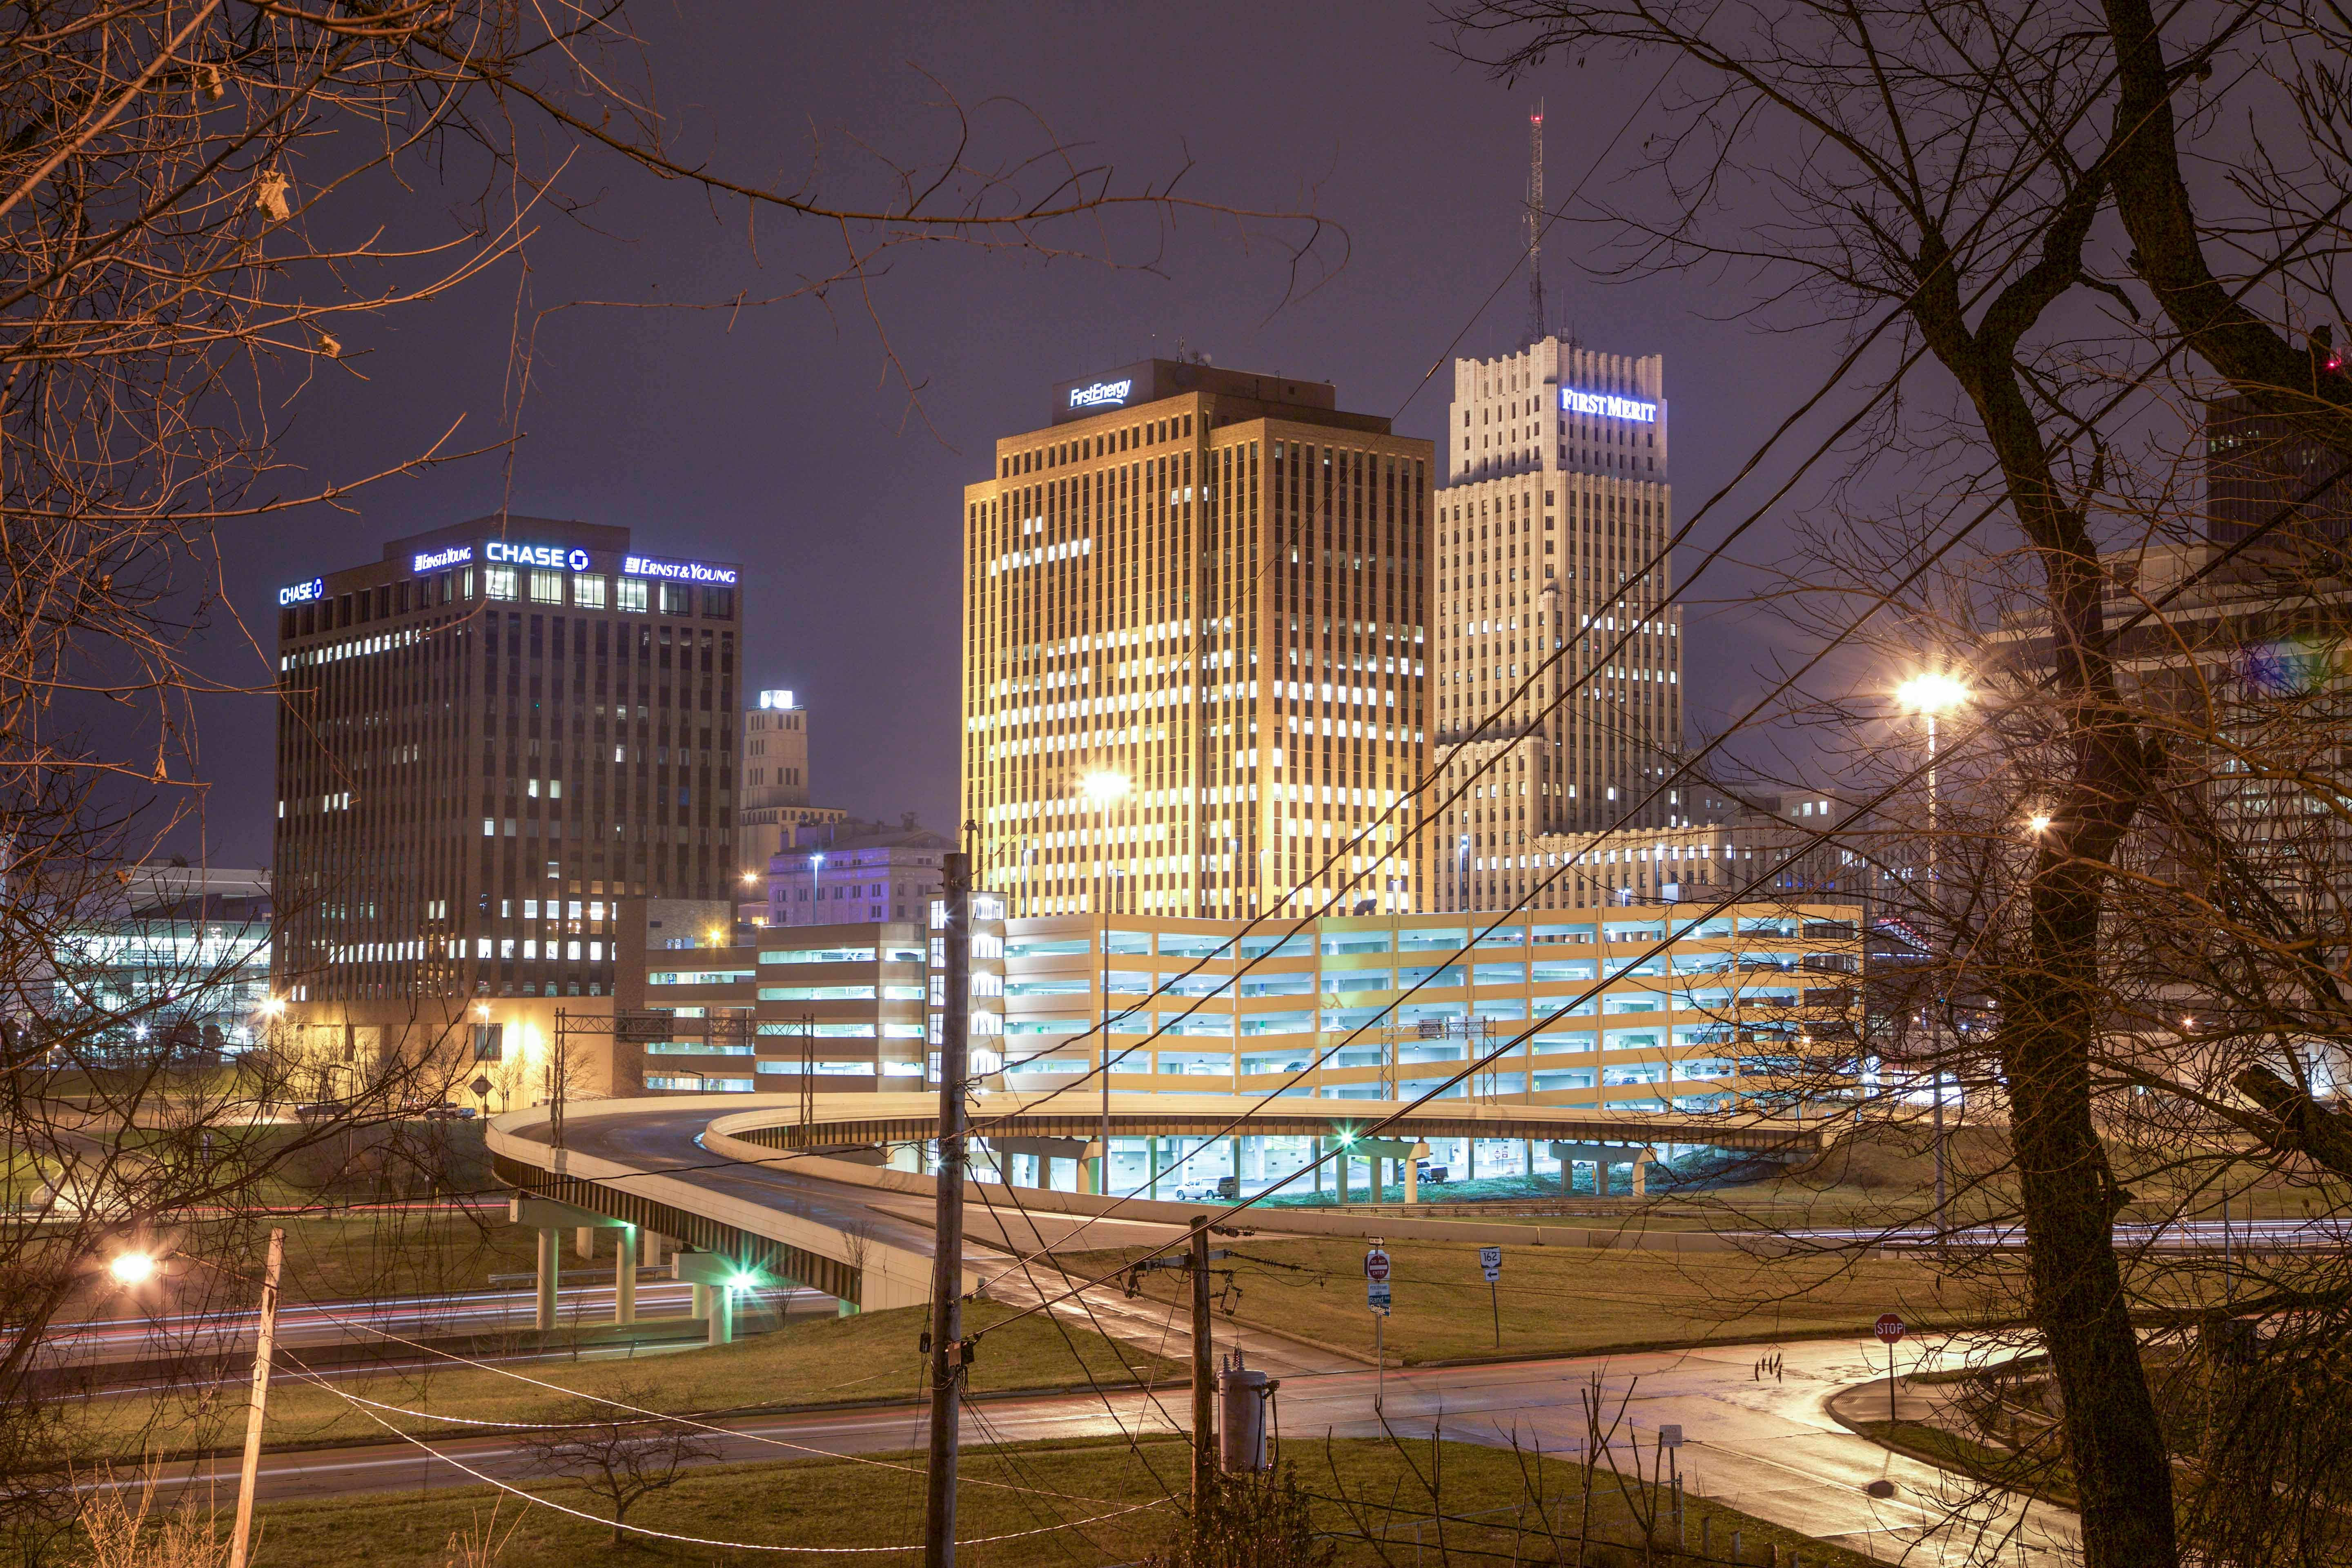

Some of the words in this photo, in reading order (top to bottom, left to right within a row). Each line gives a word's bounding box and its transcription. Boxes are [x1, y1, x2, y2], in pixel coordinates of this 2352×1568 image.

[487, 543, 565, 567] CHASE
[280, 582, 312, 605] CHASE
[1483, 1252, 1498, 1261] 162
[1877, 1323, 1903, 1334] STOP
